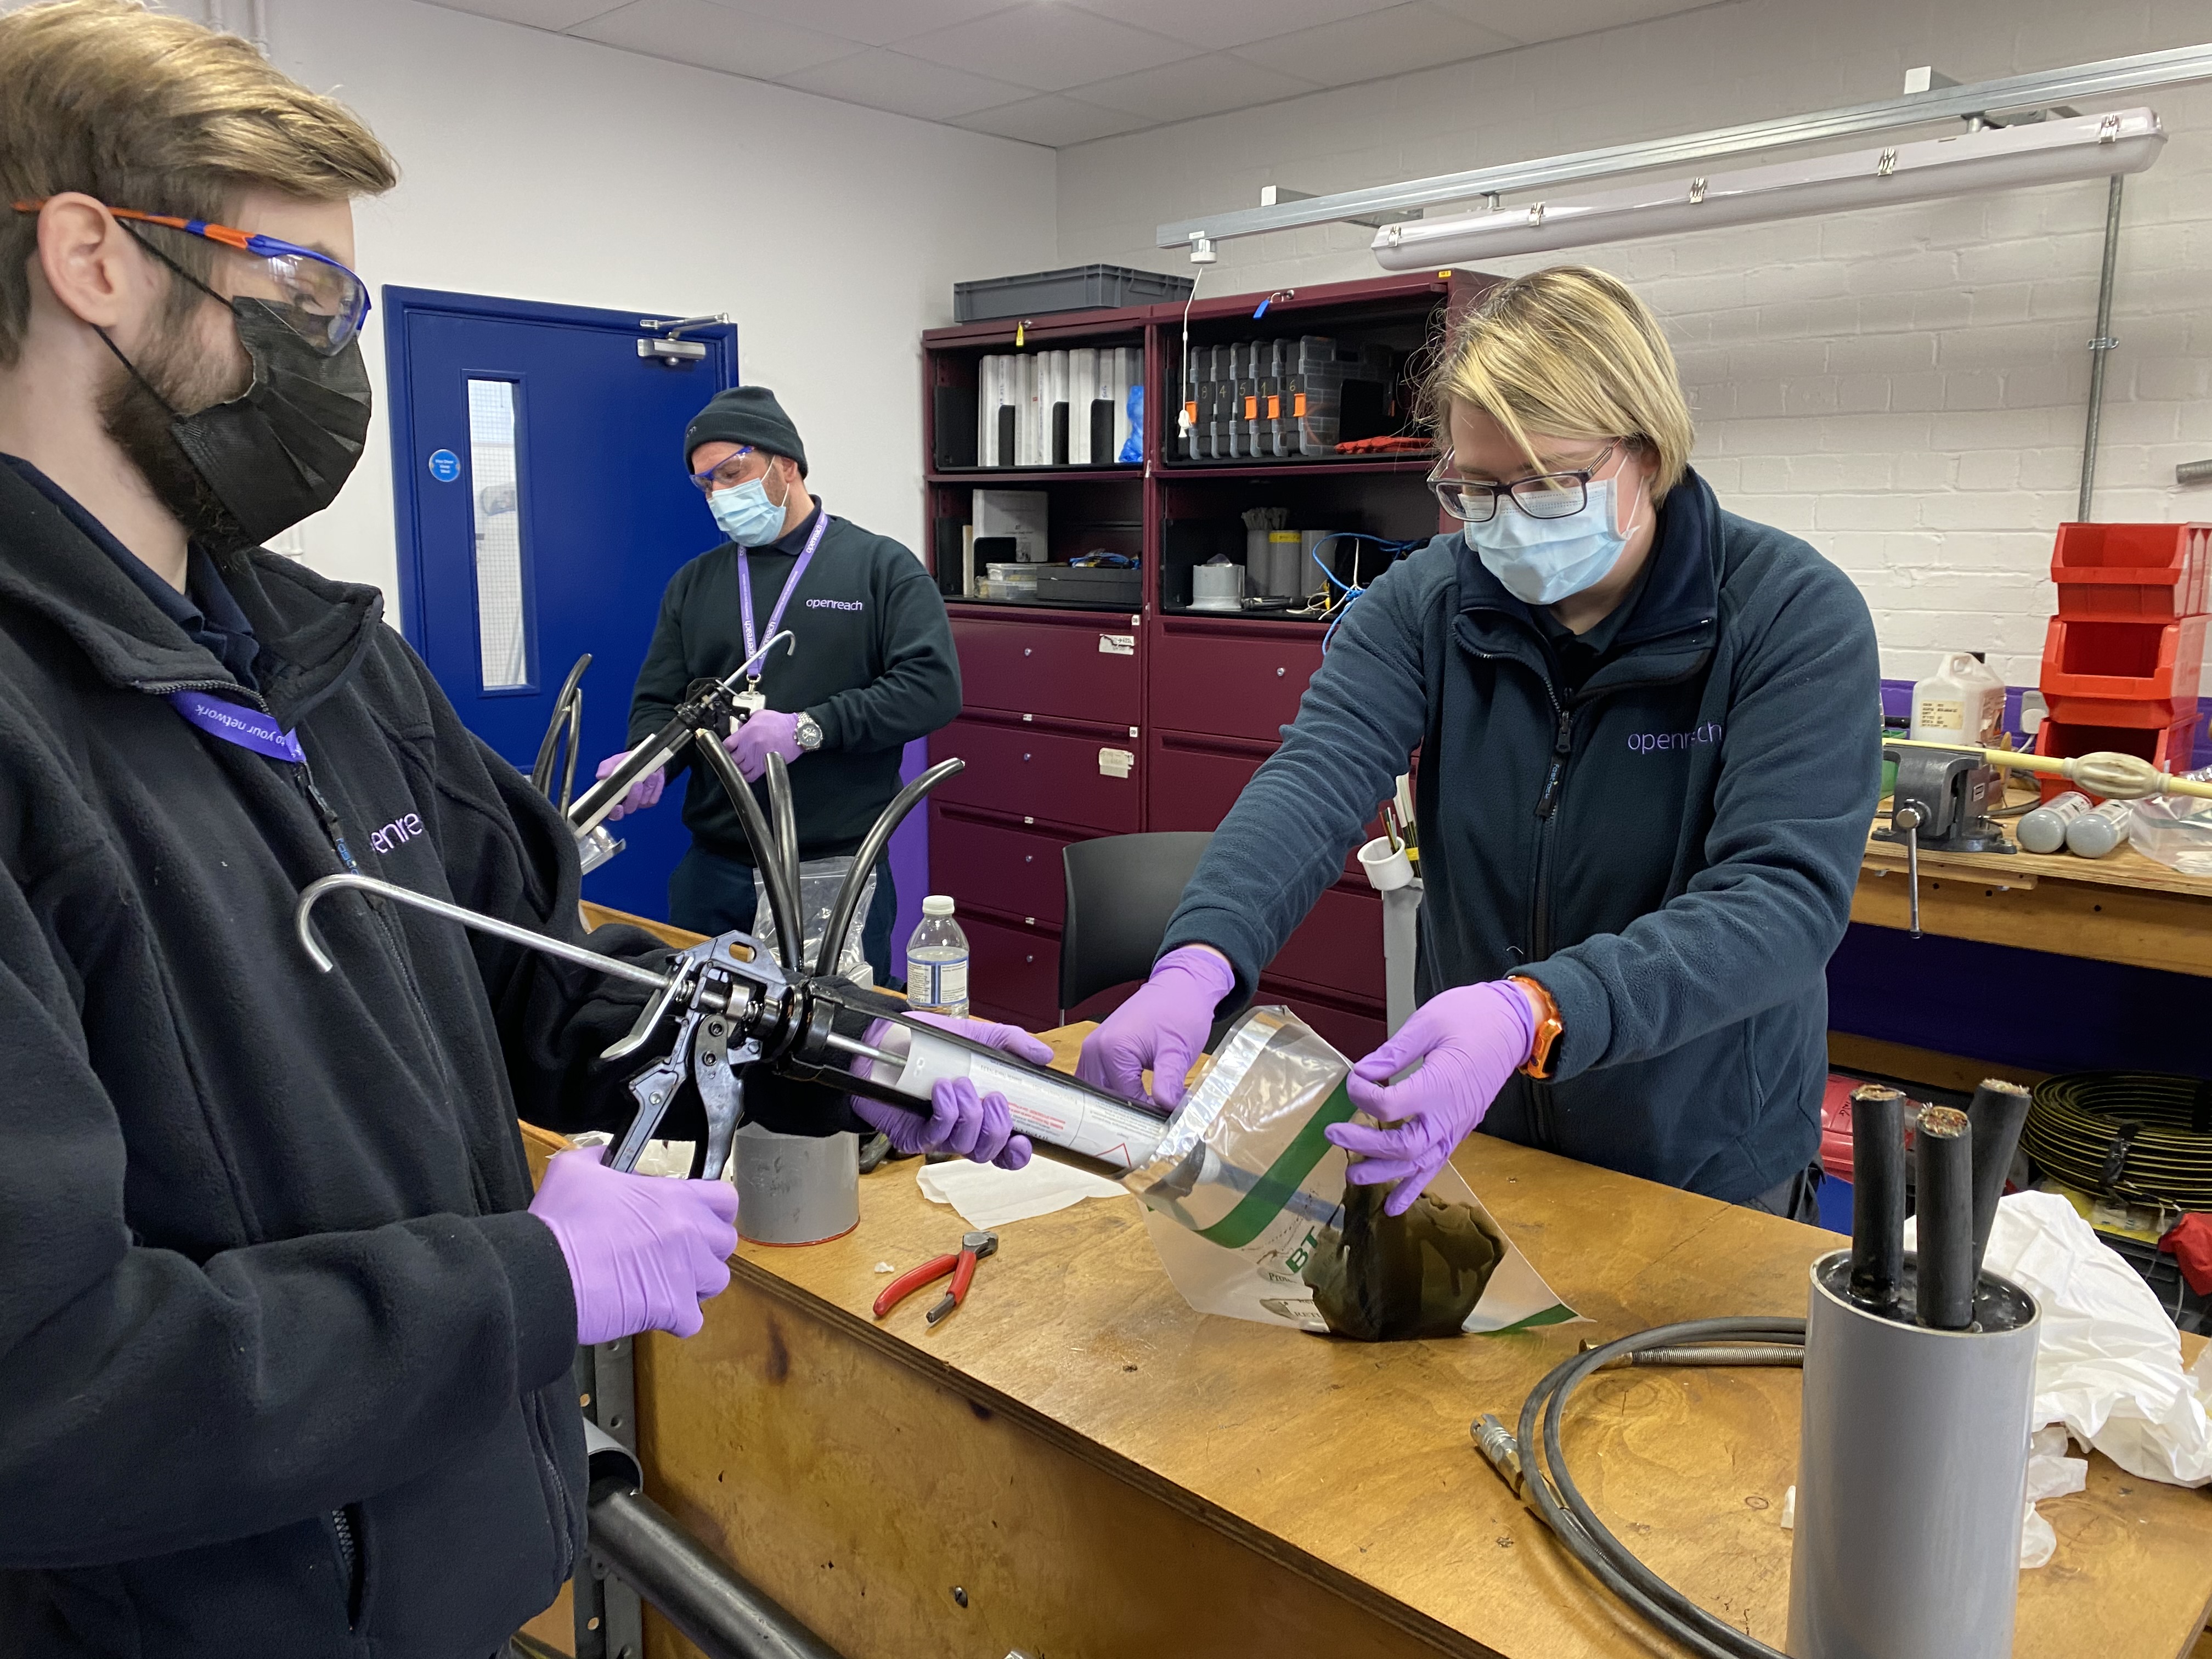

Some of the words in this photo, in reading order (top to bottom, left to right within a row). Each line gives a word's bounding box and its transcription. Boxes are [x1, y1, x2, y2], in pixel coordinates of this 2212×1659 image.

[1219, 385, 1226, 398] 4
[1239, 382, 1246, 396] 5
[1289, 379, 1296, 392] 6
[805, 524, 823, 554] openreach
[805, 598, 863, 611] openreach
[744, 620, 754, 658] openreach
[759, 621, 776, 659] onreach
[194, 704, 247, 731] network
[246, 726, 276, 742] your
[276, 735, 285, 747] to
[1627, 721, 1723, 755] openrch
[370, 812, 422, 854] enre
[1285, 1225, 1318, 1274] BT
